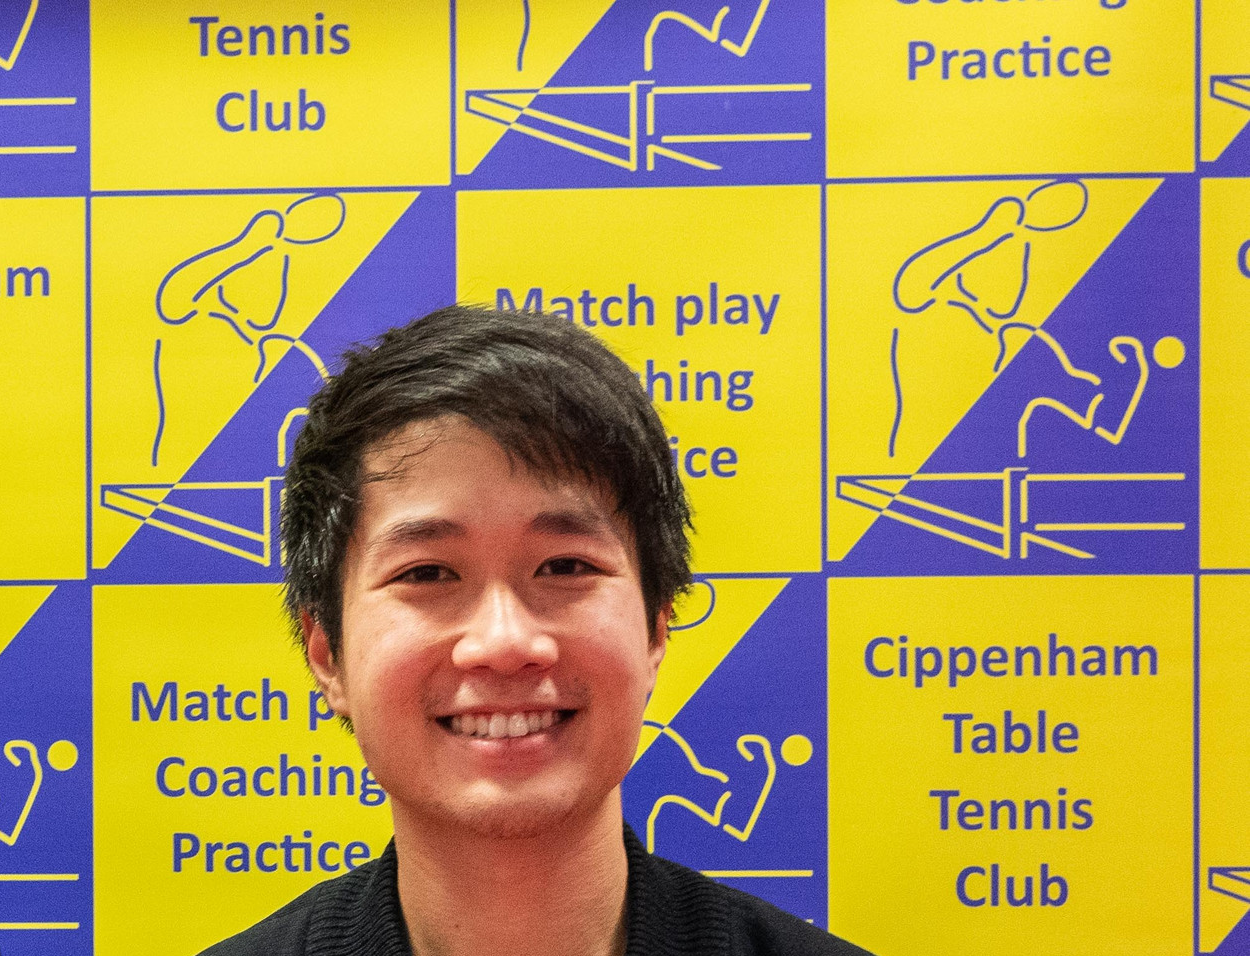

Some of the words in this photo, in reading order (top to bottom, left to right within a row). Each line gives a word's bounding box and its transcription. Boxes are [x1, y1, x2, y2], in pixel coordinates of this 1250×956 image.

[189, 13, 350, 56] Tennis
[908, 35, 1111, 80] Practice
[216, 89, 326, 133] Club
[496, 284, 655, 327] Match
[676, 282, 780, 336] play
[636, 359, 754, 412] hing
[864, 634, 1158, 688] Cippenham
[131, 678, 288, 722] Match
[943, 710, 1079, 754] Table
[156, 754, 386, 806] Coaching
[929, 787, 1093, 831] Tennis
[173, 830, 371, 873] Practice
[956, 864, 1068, 907] Club
